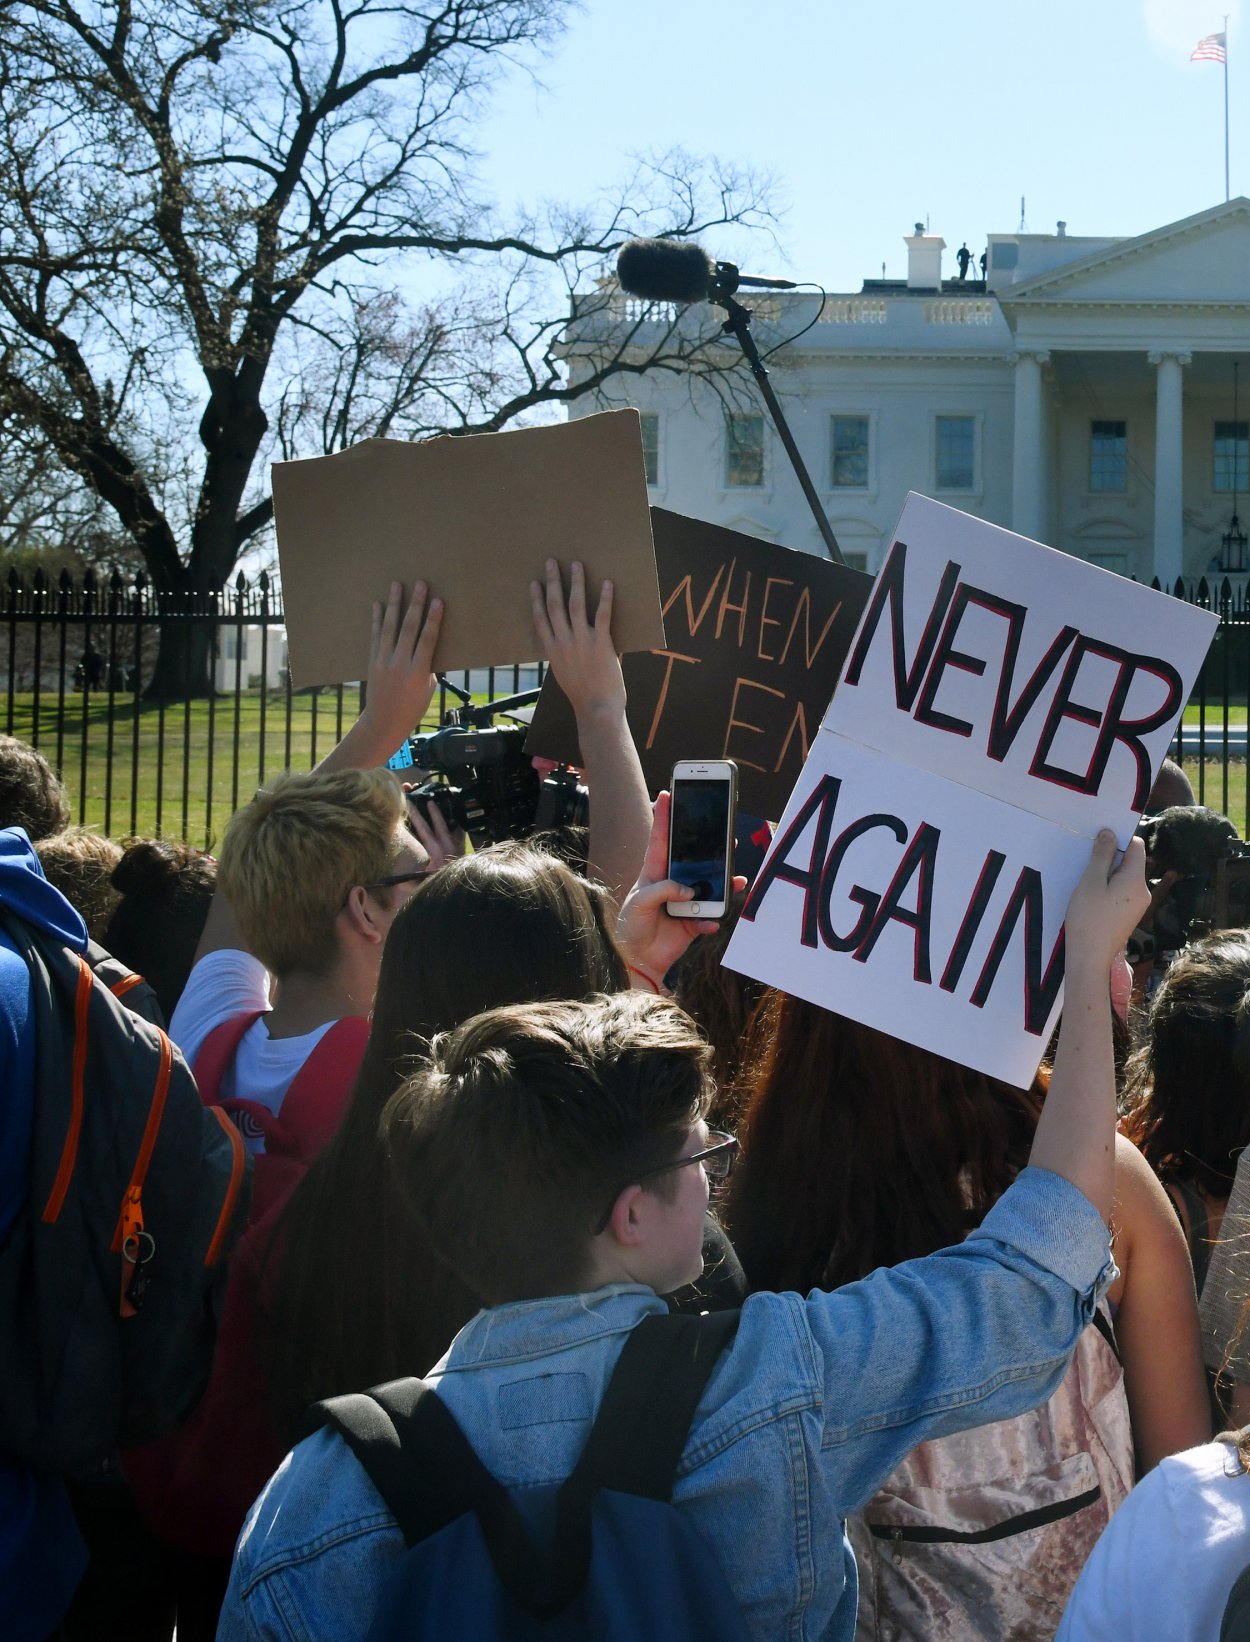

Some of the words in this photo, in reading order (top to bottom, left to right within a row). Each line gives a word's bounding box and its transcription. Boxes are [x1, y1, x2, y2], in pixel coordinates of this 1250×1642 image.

[662, 556, 842, 670] WHEN
[844, 541, 1183, 813] NEVER
[722, 677, 808, 774] EN
[741, 773, 1066, 1036] AGAIN
